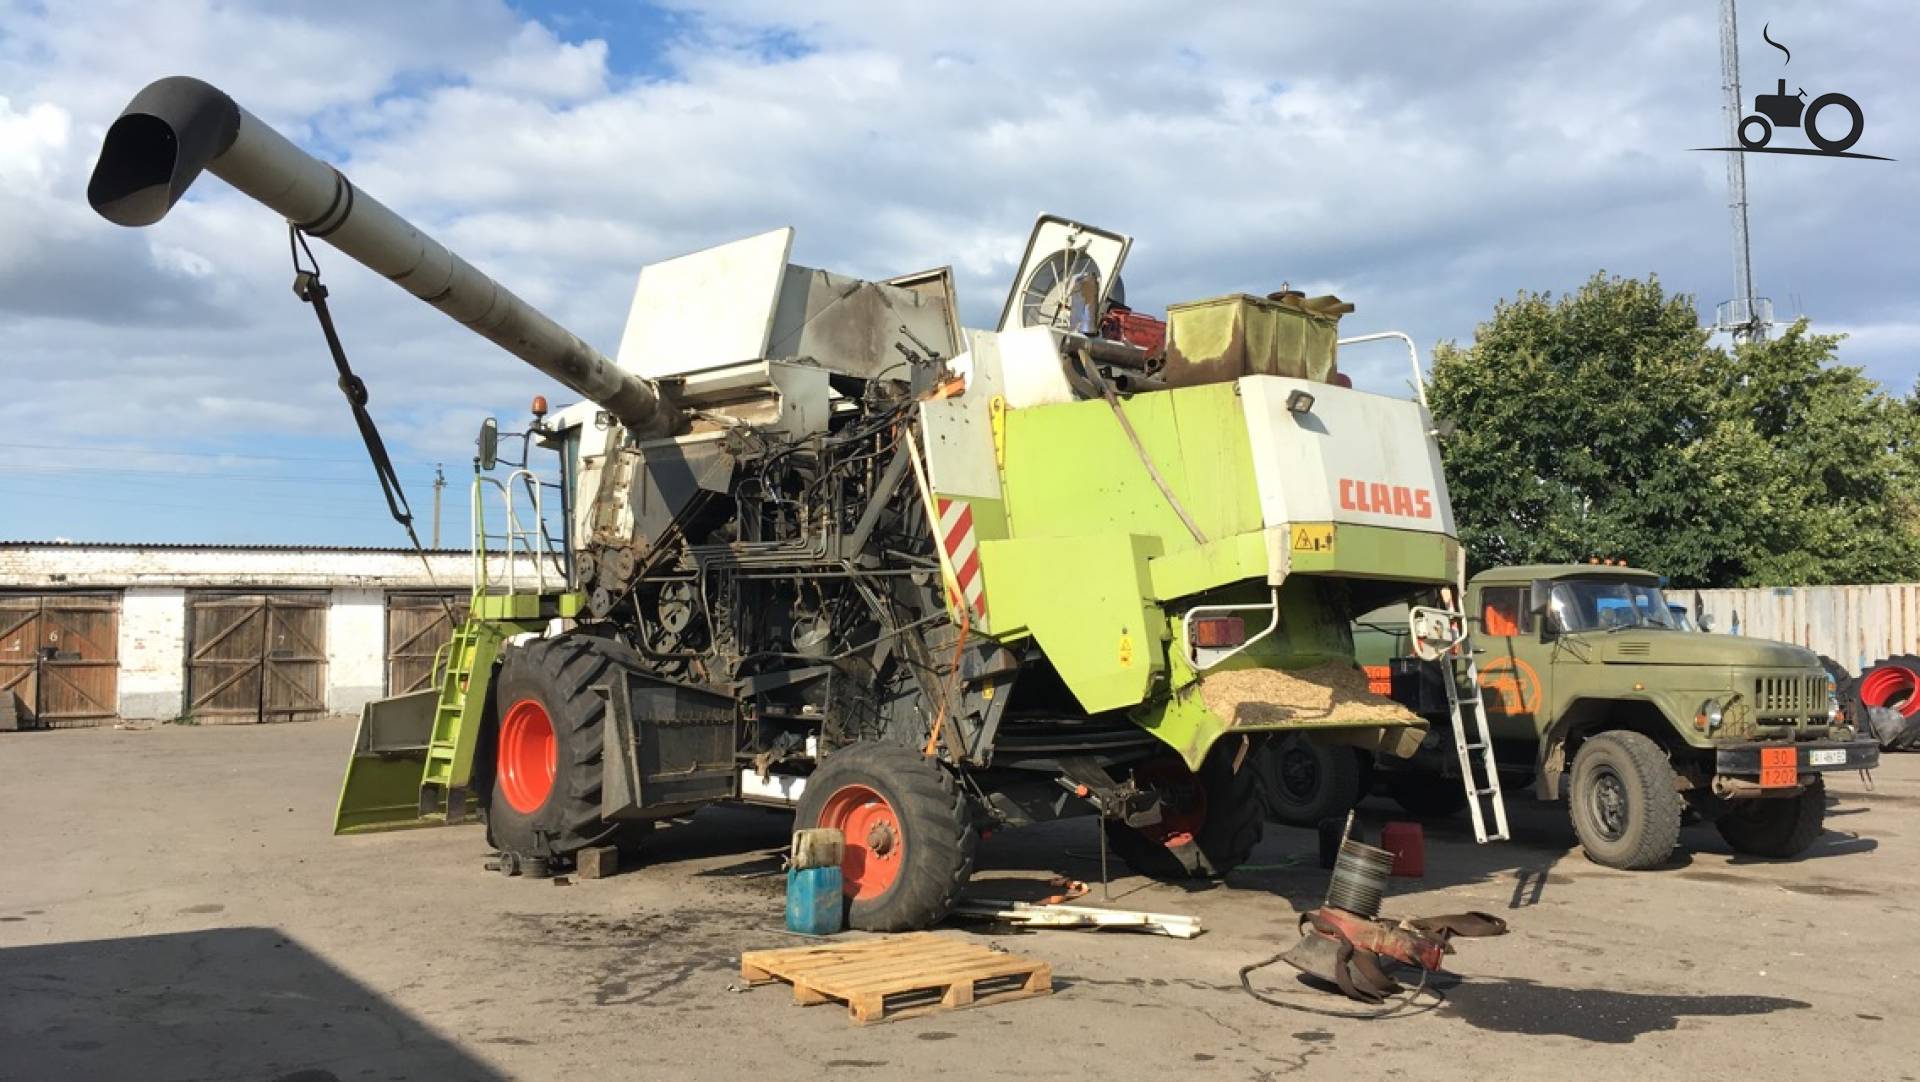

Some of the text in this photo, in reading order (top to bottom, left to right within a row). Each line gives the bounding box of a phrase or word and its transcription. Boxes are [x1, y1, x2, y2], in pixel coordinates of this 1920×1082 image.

[1339, 478, 1432, 519] CLAAS
[49, 630, 58, 642] 6
[1773, 750, 1788, 765] 30
